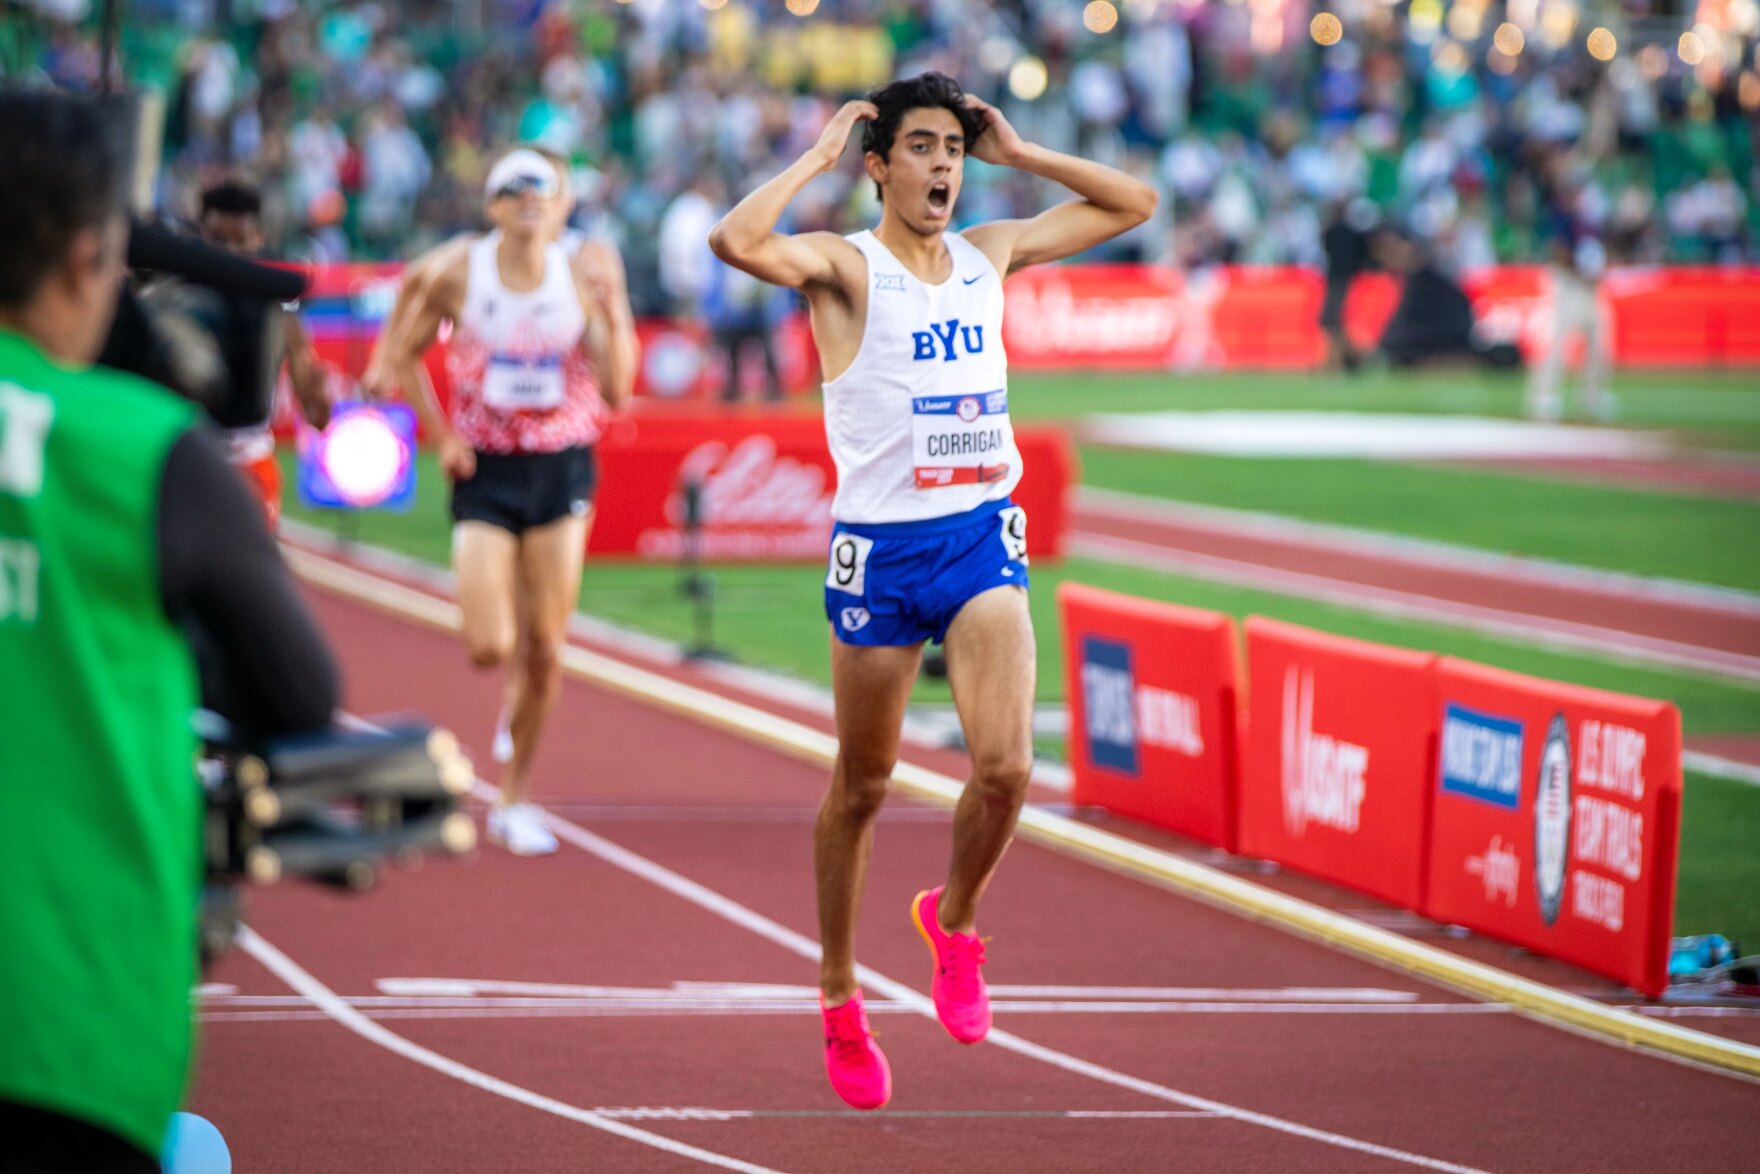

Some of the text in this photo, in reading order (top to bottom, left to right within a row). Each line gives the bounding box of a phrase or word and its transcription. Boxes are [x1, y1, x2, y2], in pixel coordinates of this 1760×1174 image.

[912, 318, 984, 362] BYU
[836, 540, 857, 586] 9
[846, 610, 864, 627] Y
